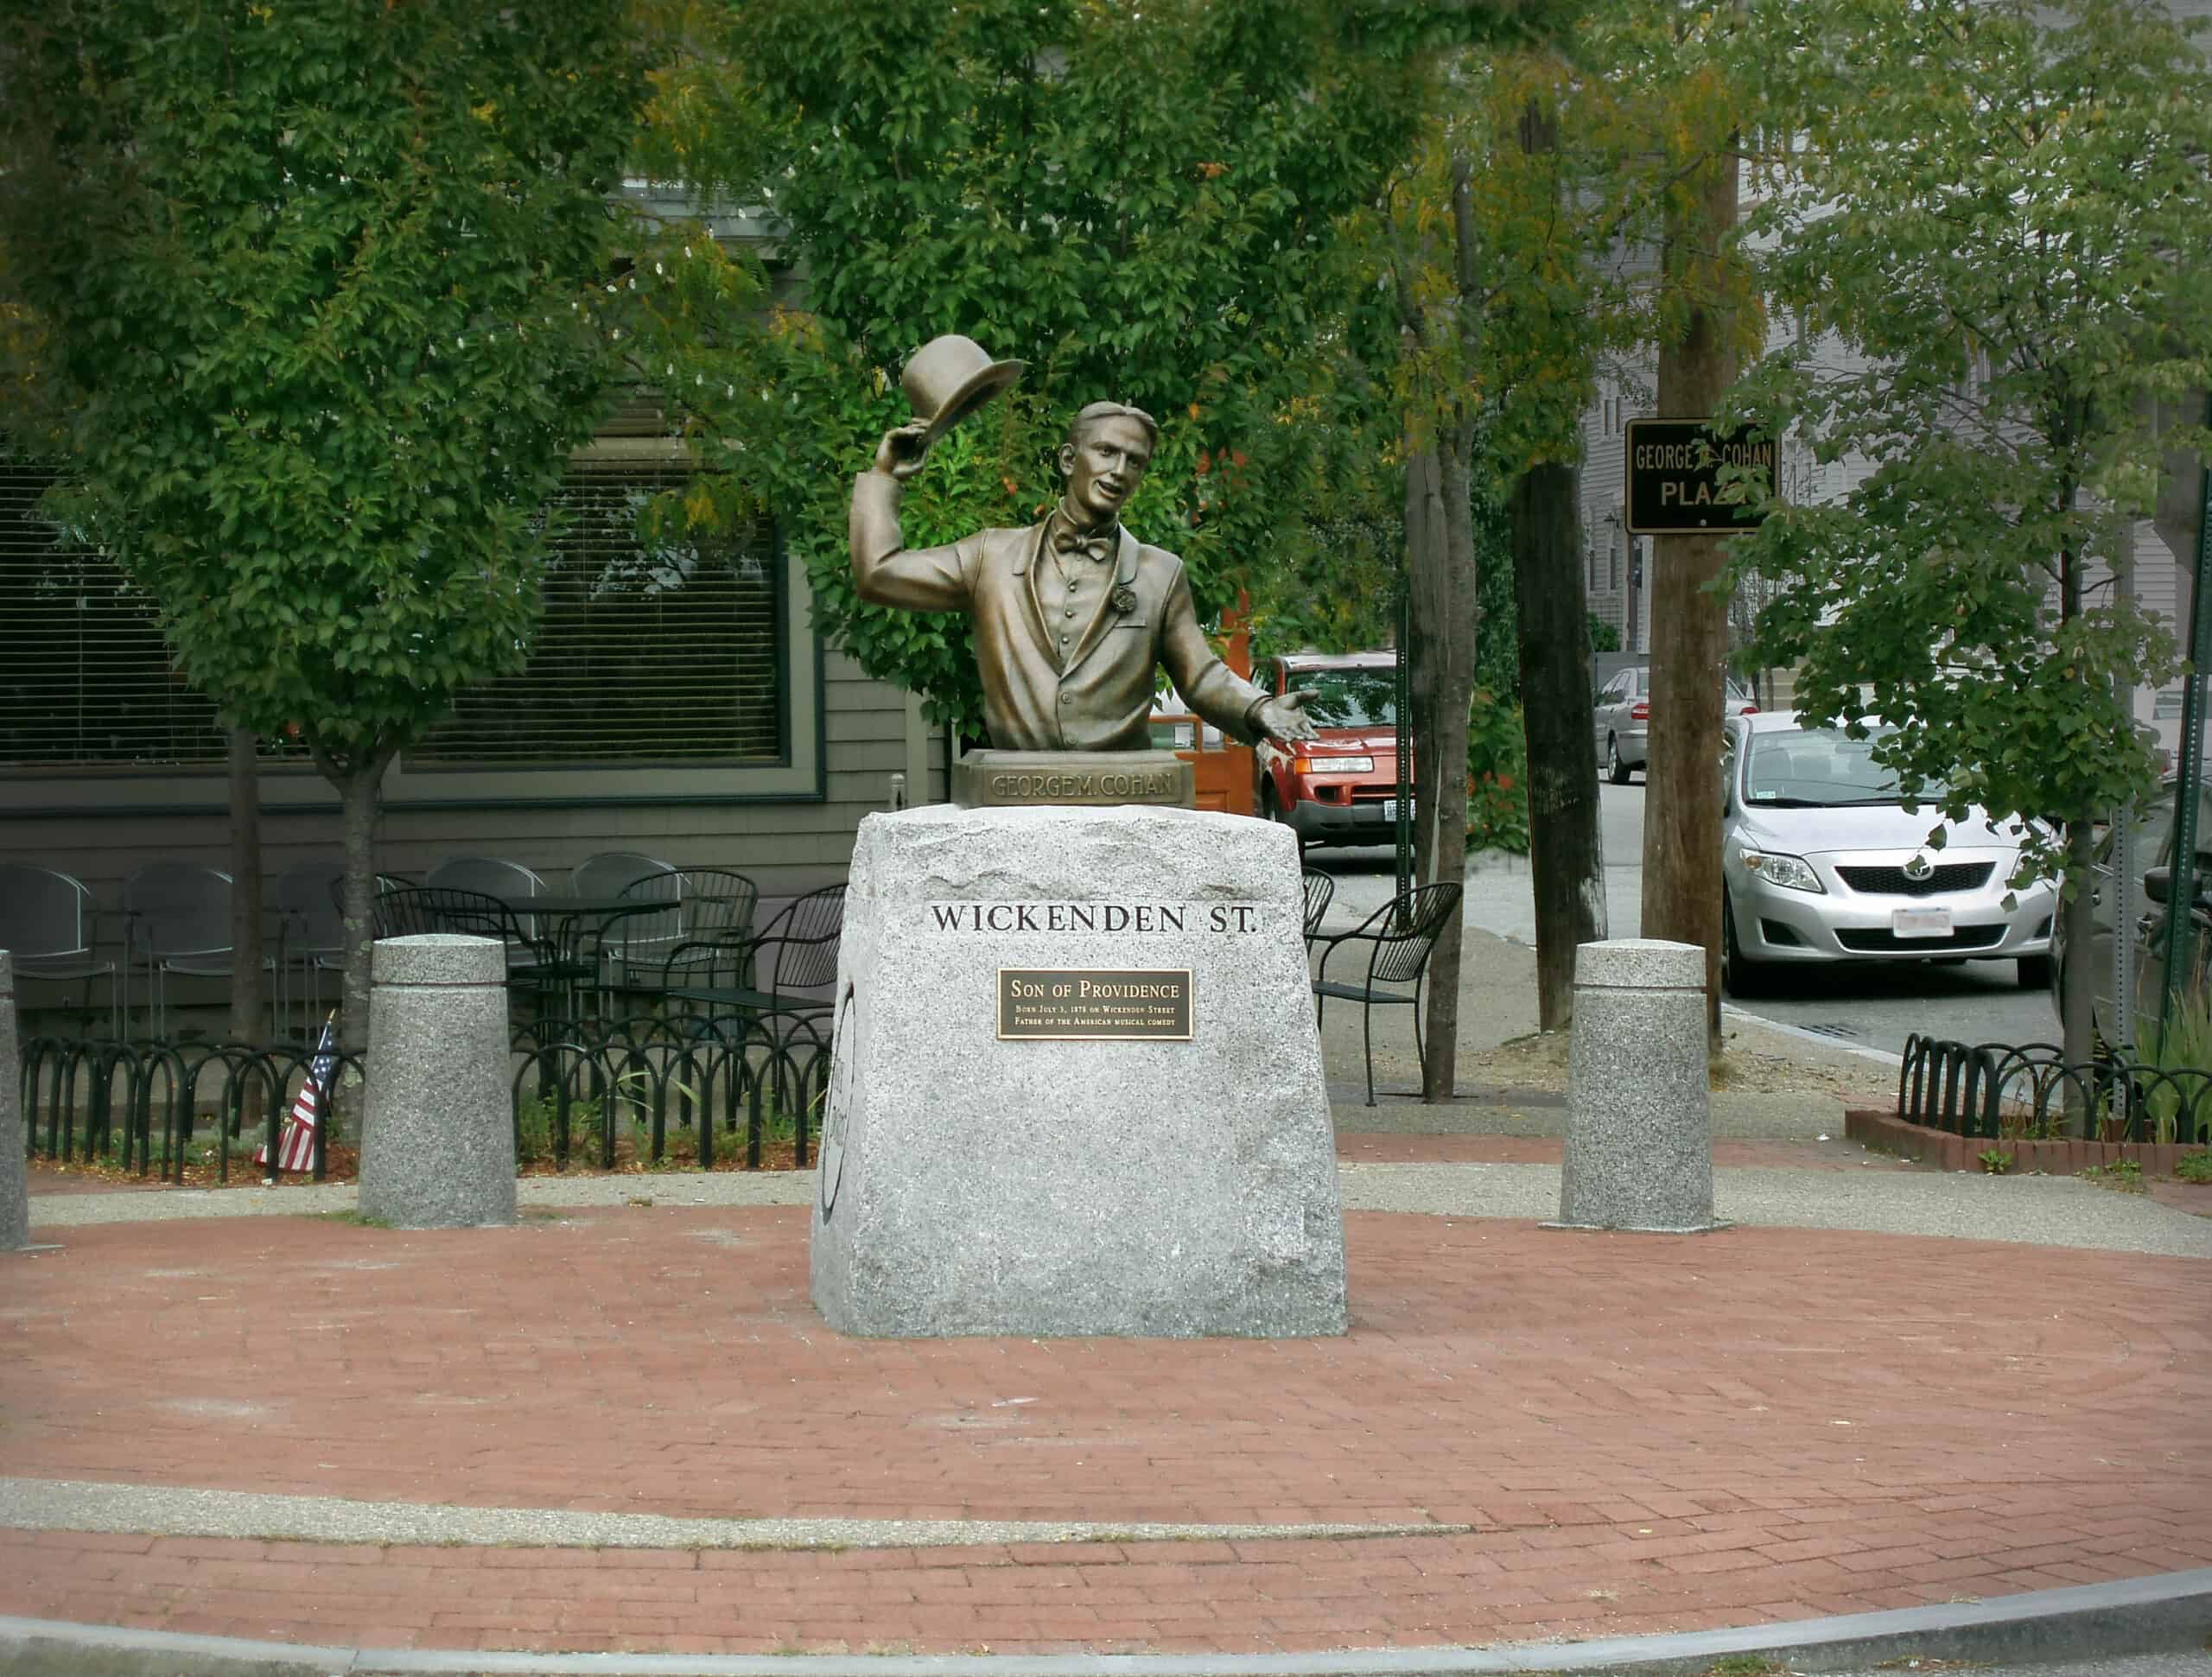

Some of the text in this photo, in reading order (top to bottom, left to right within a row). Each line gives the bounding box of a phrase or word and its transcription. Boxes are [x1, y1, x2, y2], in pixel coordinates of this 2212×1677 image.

[1636, 443, 1694, 469] GEORGE
[993, 773, 1173, 797] GEORGE M. COHAN
[932, 905, 1256, 933] WICKENDEN ST.
